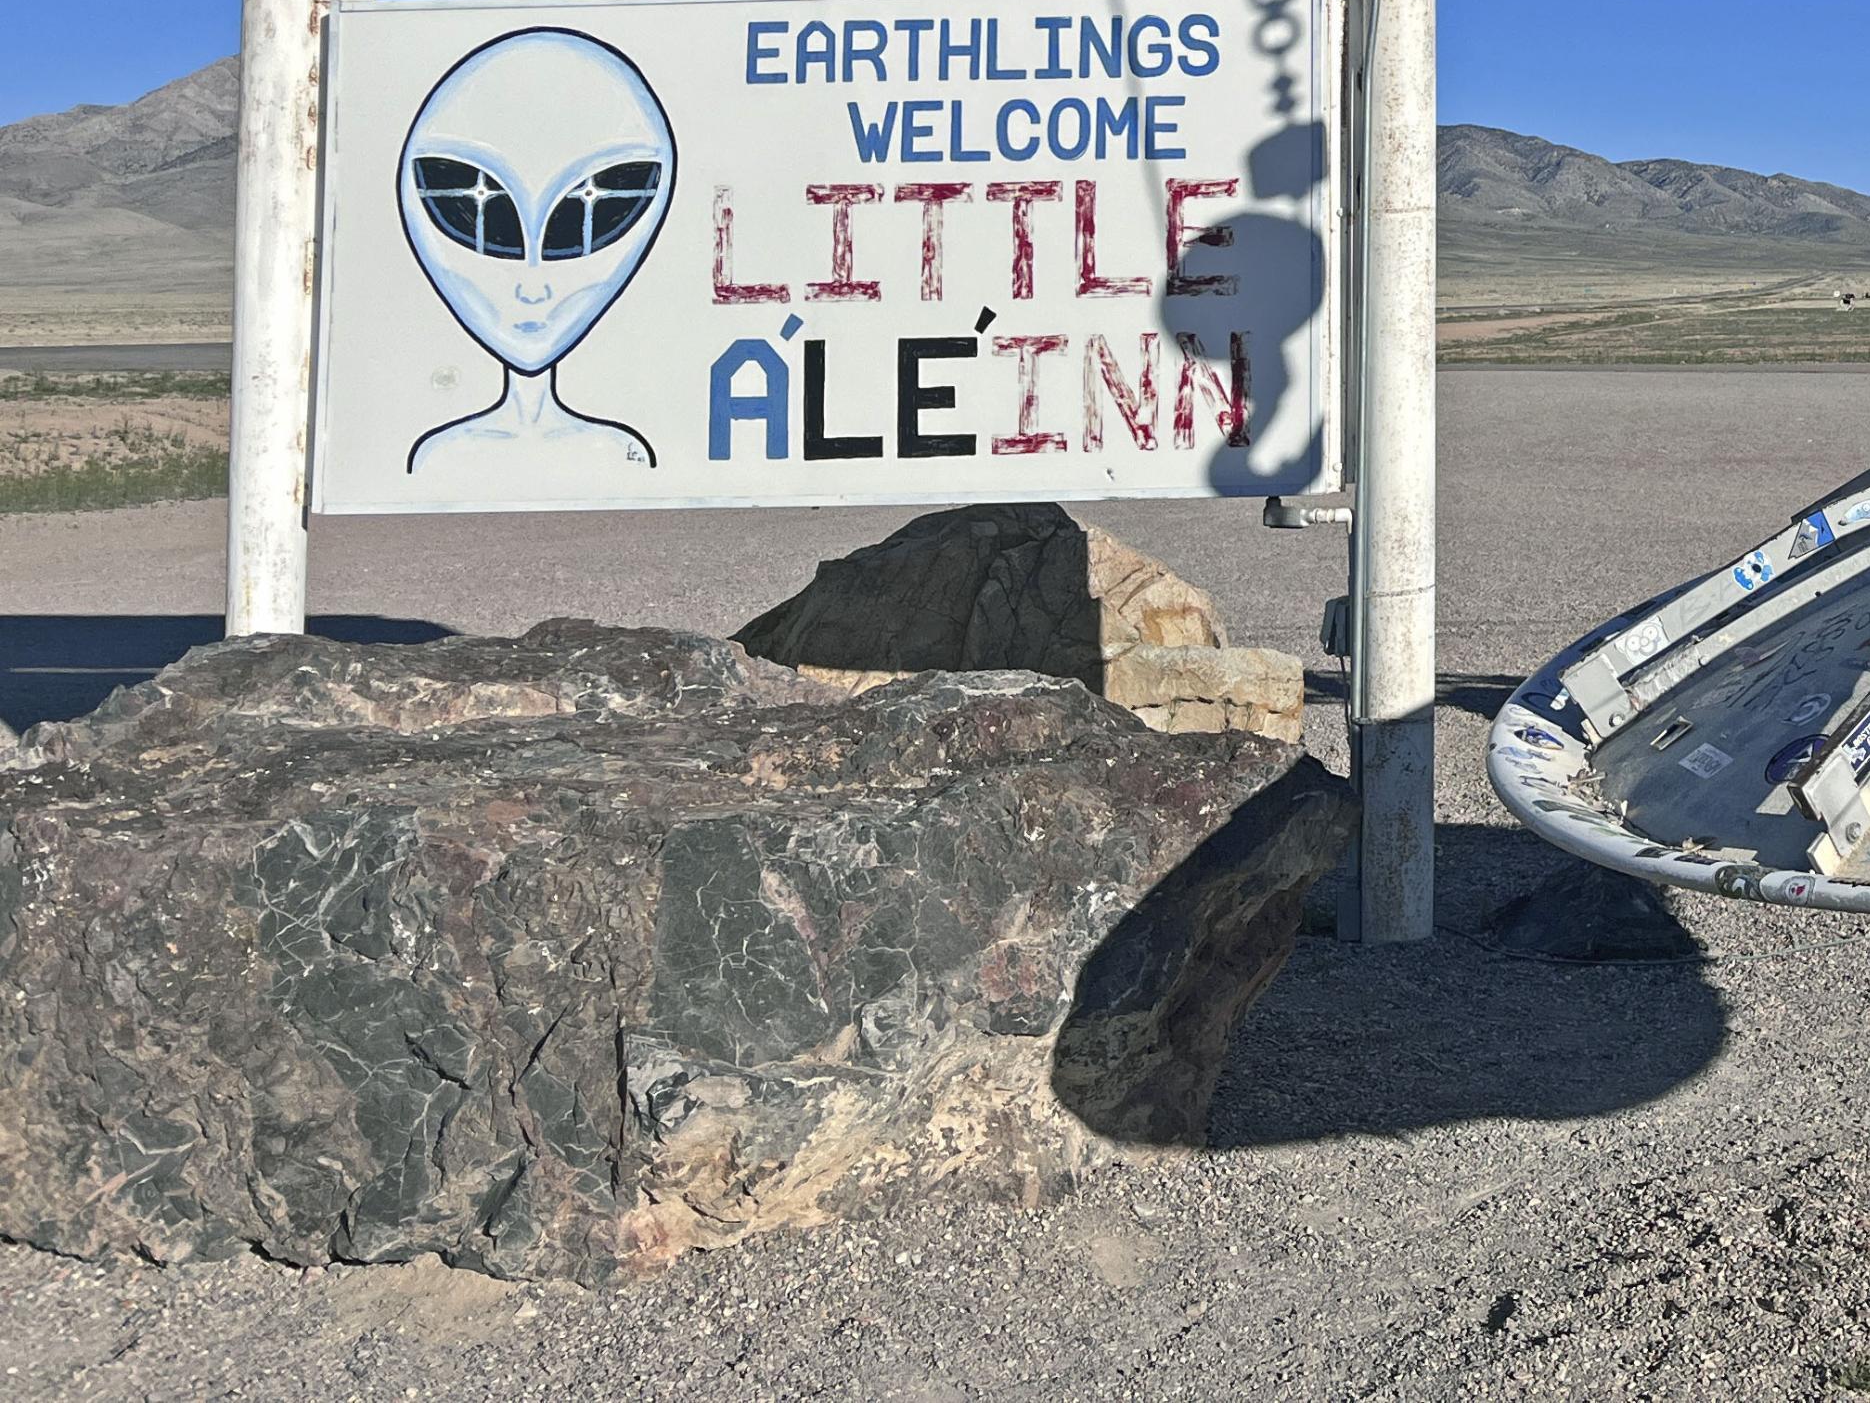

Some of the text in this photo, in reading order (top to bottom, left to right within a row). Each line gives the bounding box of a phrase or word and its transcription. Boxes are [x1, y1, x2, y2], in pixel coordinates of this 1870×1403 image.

[746, 15, 1220, 86] EARTHLINGS
[847, 96, 1187, 163] WELCOME
[711, 177, 1240, 305] LITTLE
